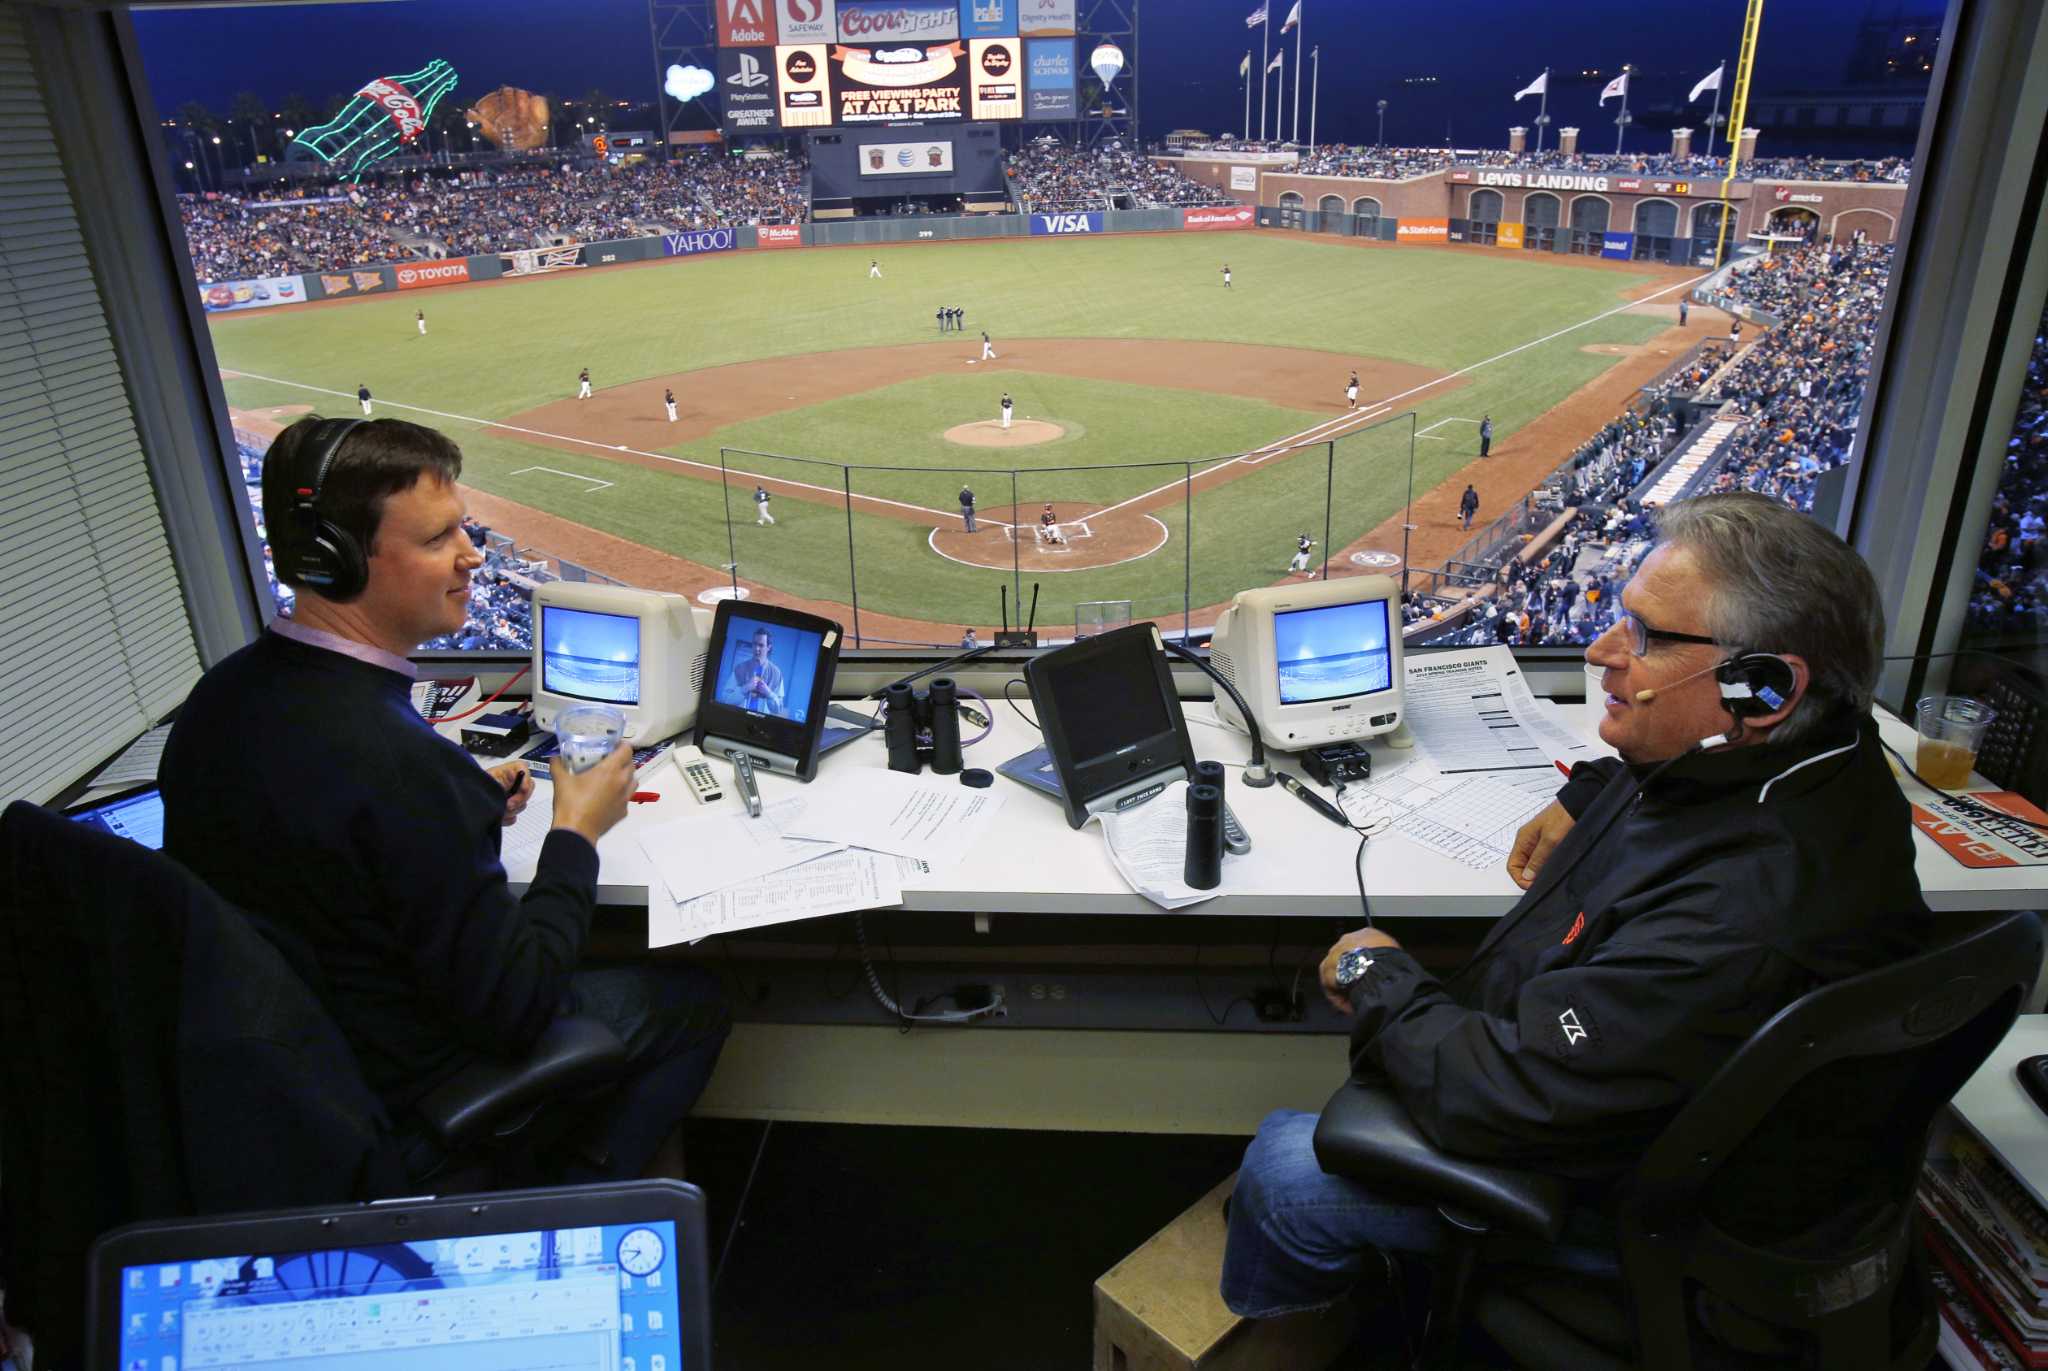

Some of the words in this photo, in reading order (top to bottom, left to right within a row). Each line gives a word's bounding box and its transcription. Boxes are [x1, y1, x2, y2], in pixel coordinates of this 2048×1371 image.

[731, 29, 765, 42] Adobe
[788, 24, 824, 32] SAFEWAY
[841, 90, 871, 101] FREE
[871, 88, 921, 100] VIEWING
[922, 87, 960, 98] PARTY
[842, 101, 864, 114] AT
[866, 99, 912, 113] AT&T
[914, 97, 961, 112] PARK
[727, 109, 774, 118] GREATNESS
[1526, 174, 1608, 191] LANDING
[1043, 215, 1090, 233] VISA
[666, 228, 734, 256] YAHOO!
[418, 265, 468, 281] TOYOTA
[1424, 663, 1462, 672] FRANCISCO
